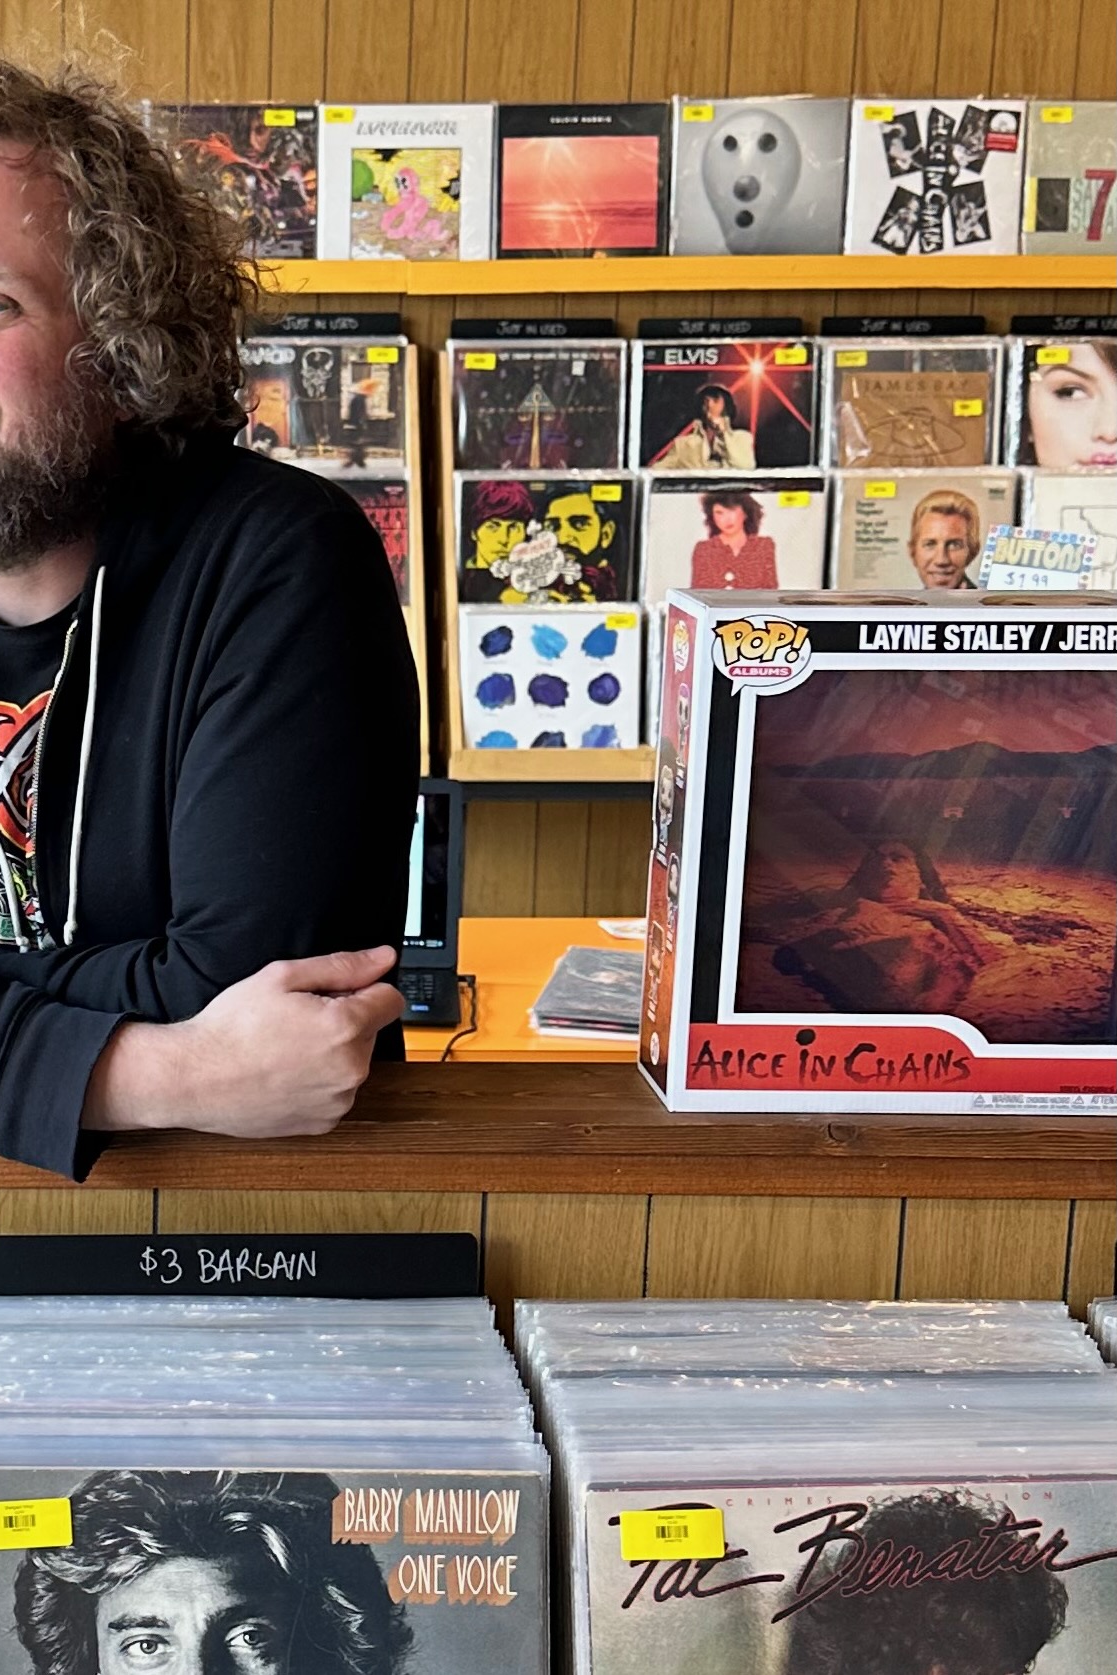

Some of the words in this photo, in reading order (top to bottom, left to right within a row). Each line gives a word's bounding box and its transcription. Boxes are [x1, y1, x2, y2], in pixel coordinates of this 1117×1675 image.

[665, 347, 719, 365] ELVIS
[863, 380, 926, 392] JAMES
[993, 536, 1085, 572] BUTTONS
[859, 624, 936, 650] LAYNE
[943, 624, 1036, 650] STALEY
[1040, 624, 1054, 651] /
[732, 667, 789, 676] ALBUMS
[691, 1040, 785, 1084] ALICE
[843, 1042, 973, 1084] CHAINS
[139, 1246, 183, 1284] $3
[198, 1248, 316, 1282] BARGAIN
[344, 1487, 402, 1533] BARRY
[415, 1489, 520, 1534] MANILOW
[725, 1497, 834, 1508] CRIMES
[398, 1555, 446, 1595] ONE
[455, 1555, 518, 1596] VOICE
[770, 1502, 1117, 1625] Benatar
